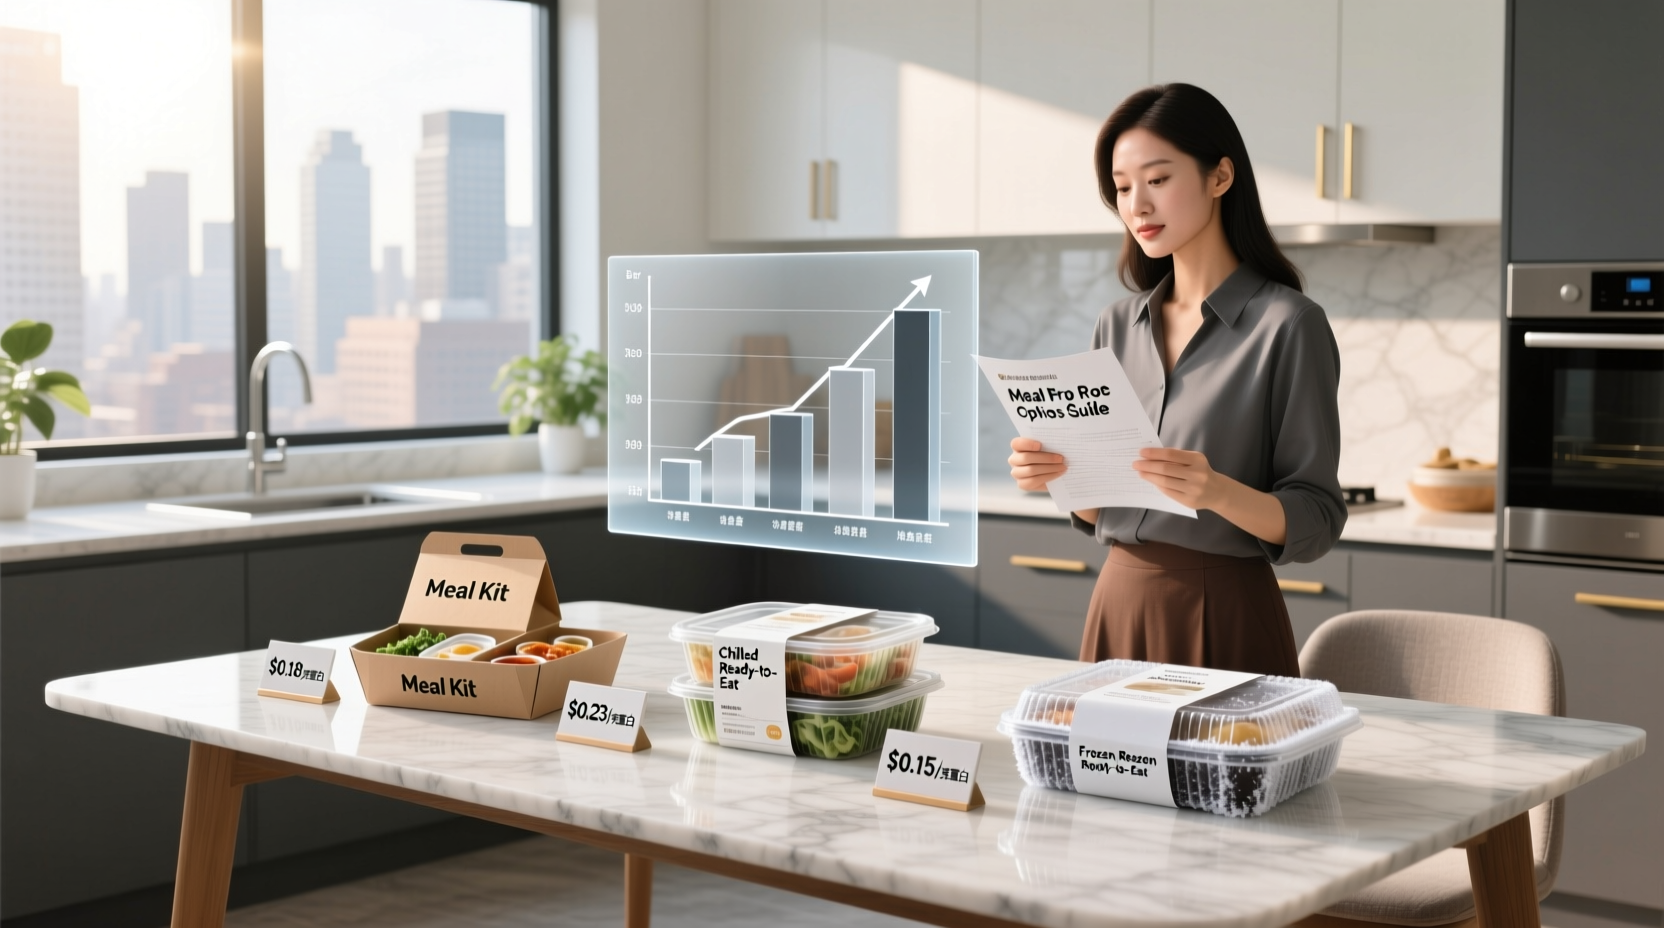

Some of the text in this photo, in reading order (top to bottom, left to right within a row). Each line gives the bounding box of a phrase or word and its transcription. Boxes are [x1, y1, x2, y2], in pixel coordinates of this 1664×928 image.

[1008, 388, 1045, 403] Meal
[425, 579, 510, 602] Meal Kit
[719, 646, 759, 661] Chilled
[719, 662, 778, 680] Ready-to-
[401, 674, 478, 698] Meal Kit
[719, 677, 740, 691] Eat
